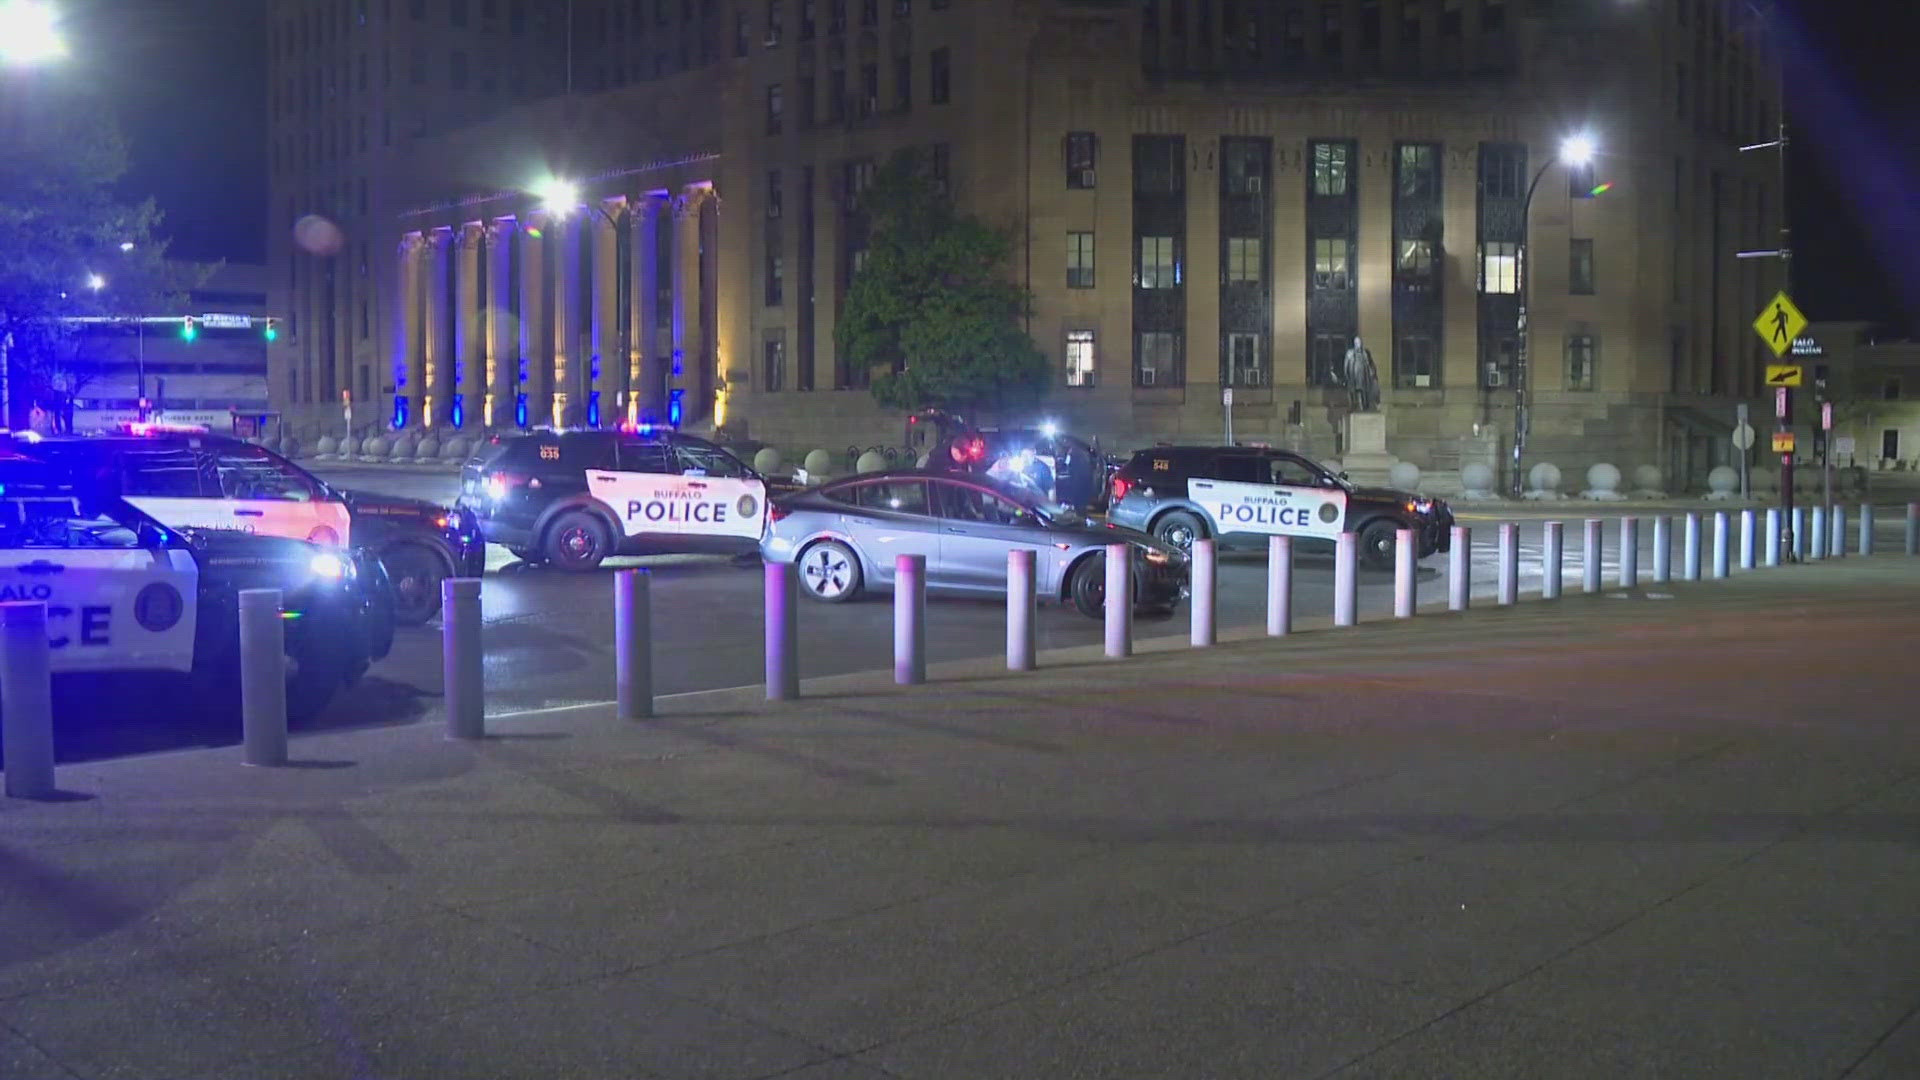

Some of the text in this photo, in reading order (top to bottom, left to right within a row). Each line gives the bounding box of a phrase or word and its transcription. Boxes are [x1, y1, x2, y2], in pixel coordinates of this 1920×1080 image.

[654, 490, 702, 499] BUFFALO
[1244, 496, 1287, 506] BUFFALO
[627, 501, 727, 523] POLICE
[1220, 503, 1310, 526] POLICE
